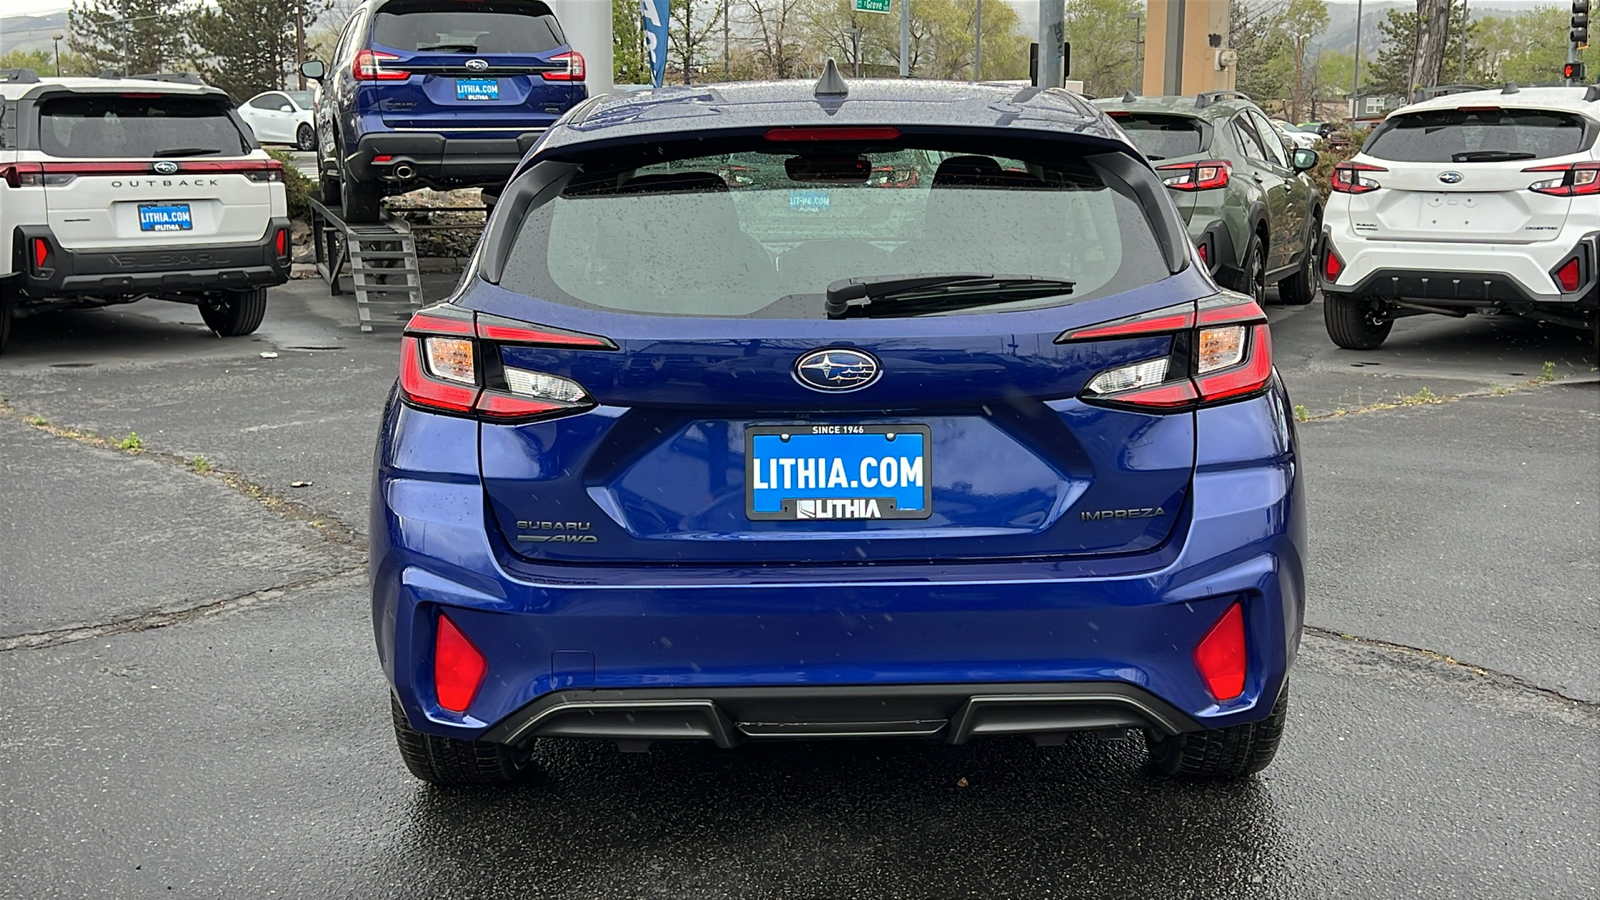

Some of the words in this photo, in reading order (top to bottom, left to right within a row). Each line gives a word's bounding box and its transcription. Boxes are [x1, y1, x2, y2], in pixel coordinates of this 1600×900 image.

[457, 84, 498, 93] LITHIA.COM
[111, 179, 219, 188] OUTBACK
[141, 211, 190, 223] LITHIA.COM
[812, 426, 841, 434] SINCE
[843, 426, 864, 434] 1946
[753, 456, 923, 490] LITHIA.COM
[815, 499, 882, 518] LITHIA
[1081, 507, 1166, 521] IMPREZA
[516, 520, 591, 531] SUBARU
[546, 535, 598, 543] AWD
